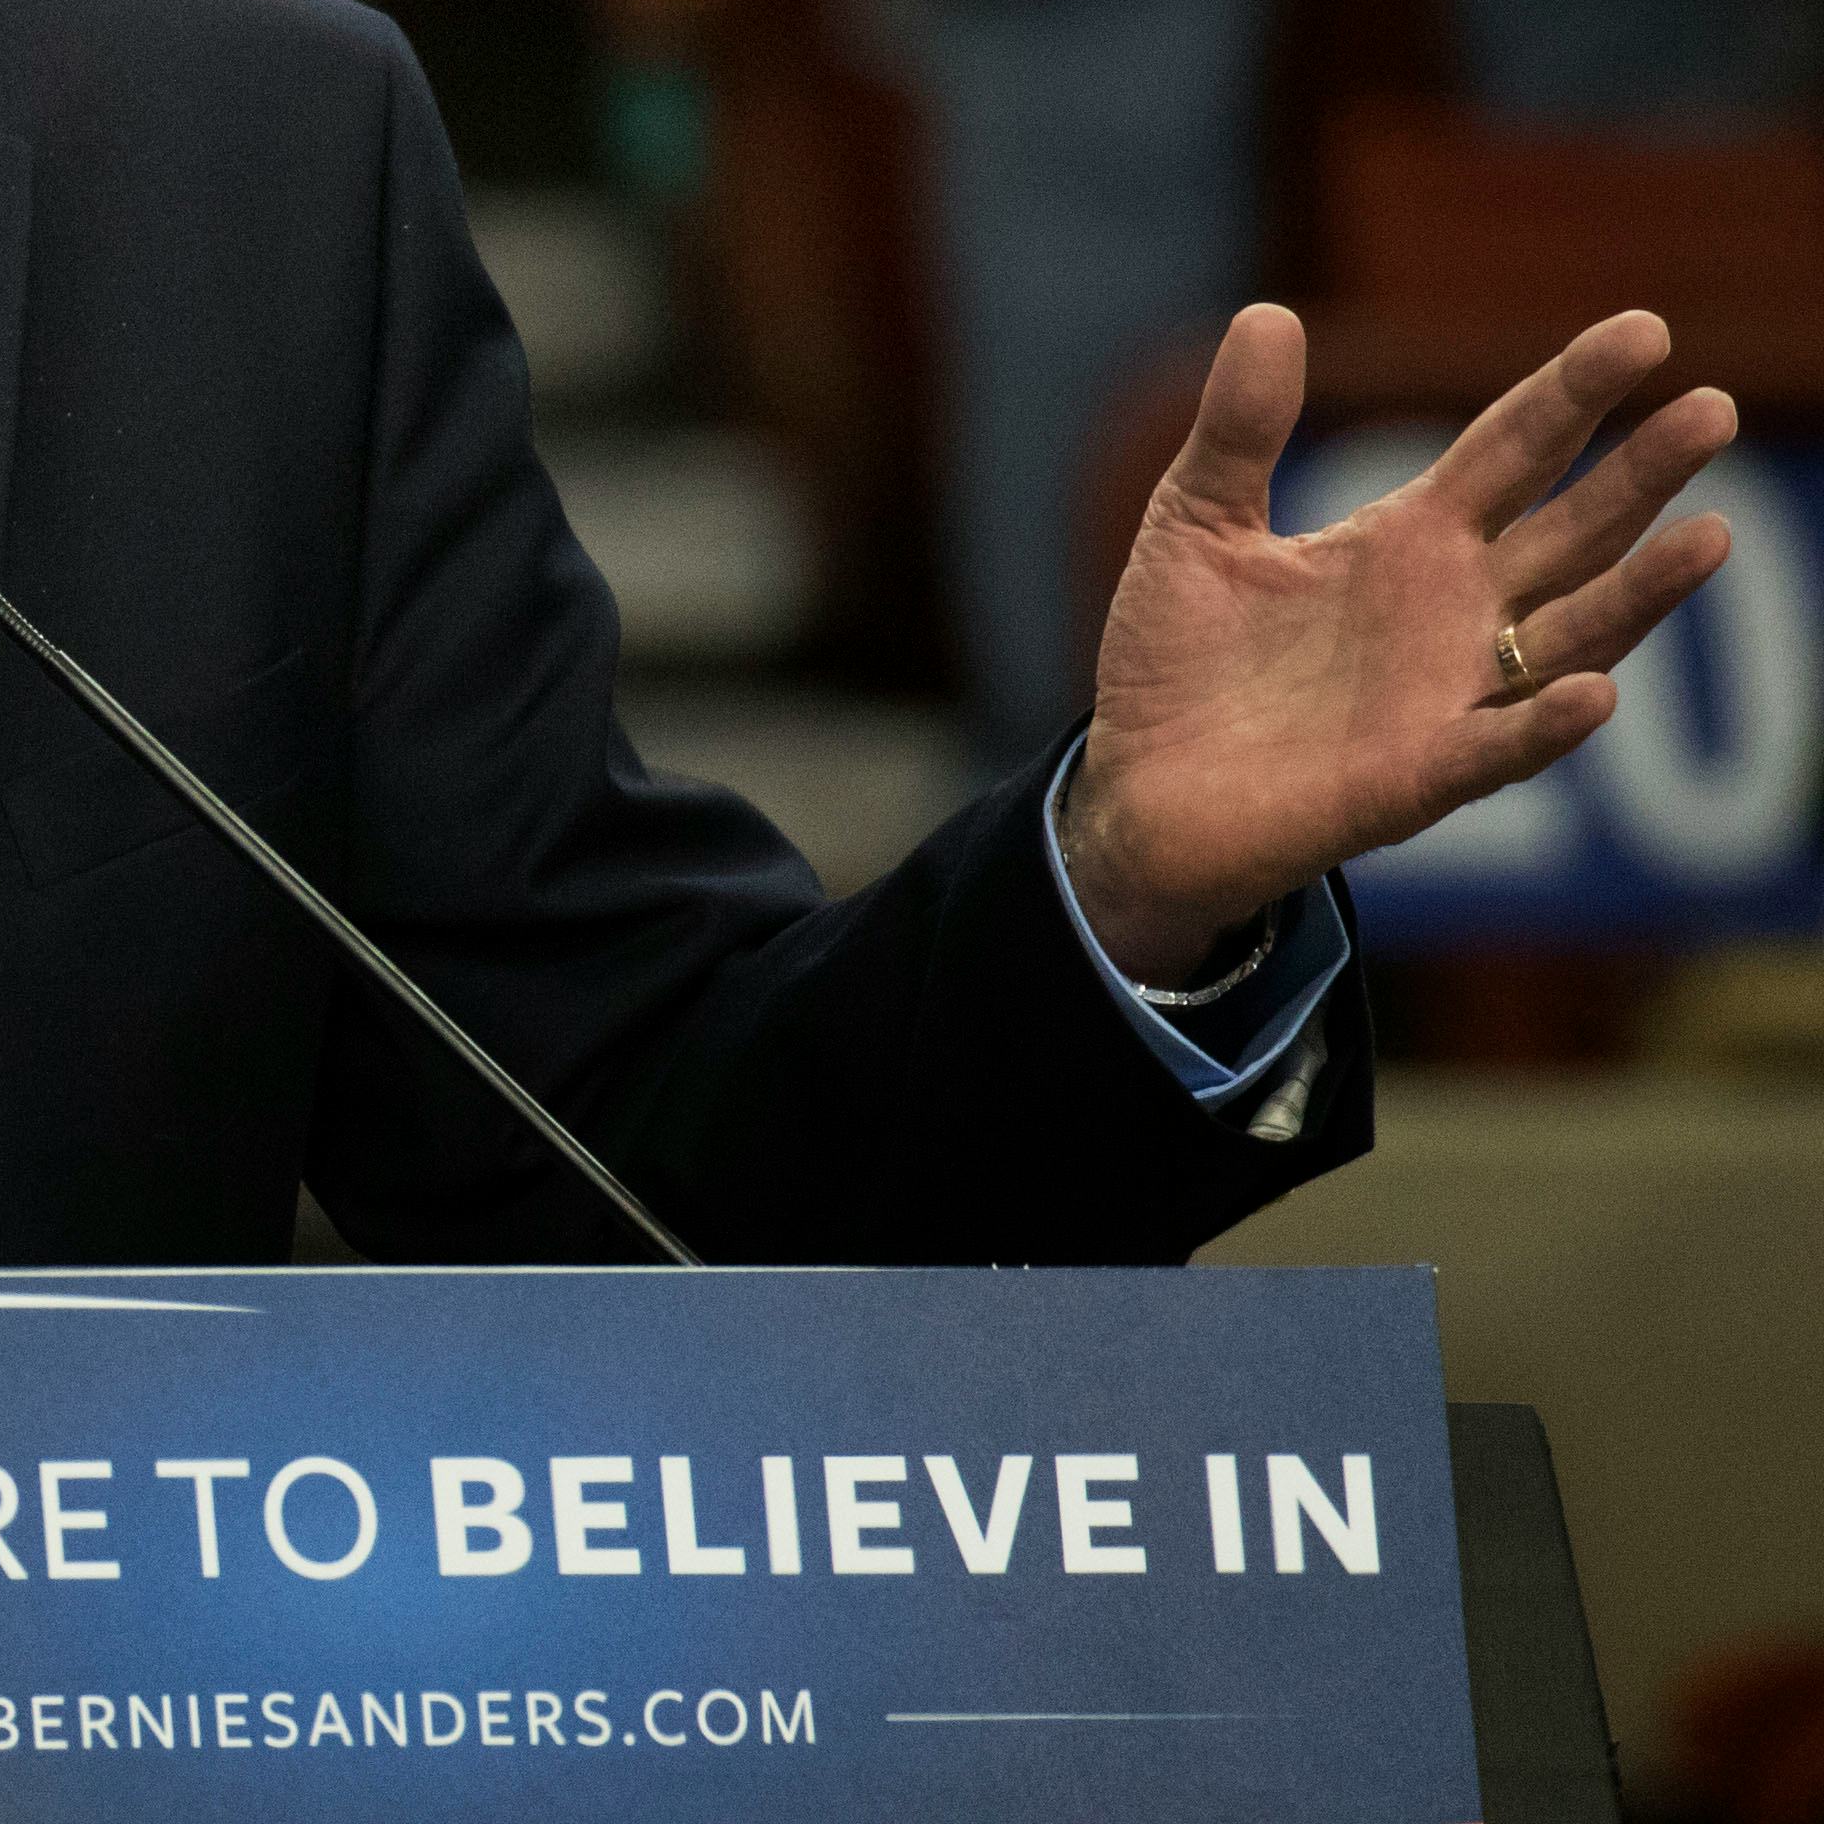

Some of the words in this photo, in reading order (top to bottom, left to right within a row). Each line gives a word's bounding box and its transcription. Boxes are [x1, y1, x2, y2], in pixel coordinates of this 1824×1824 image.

[153, 1454, 380, 1583] TO
[428, 1452, 1149, 1579] BELIEVE
[1203, 1452, 1382, 1576] IN
